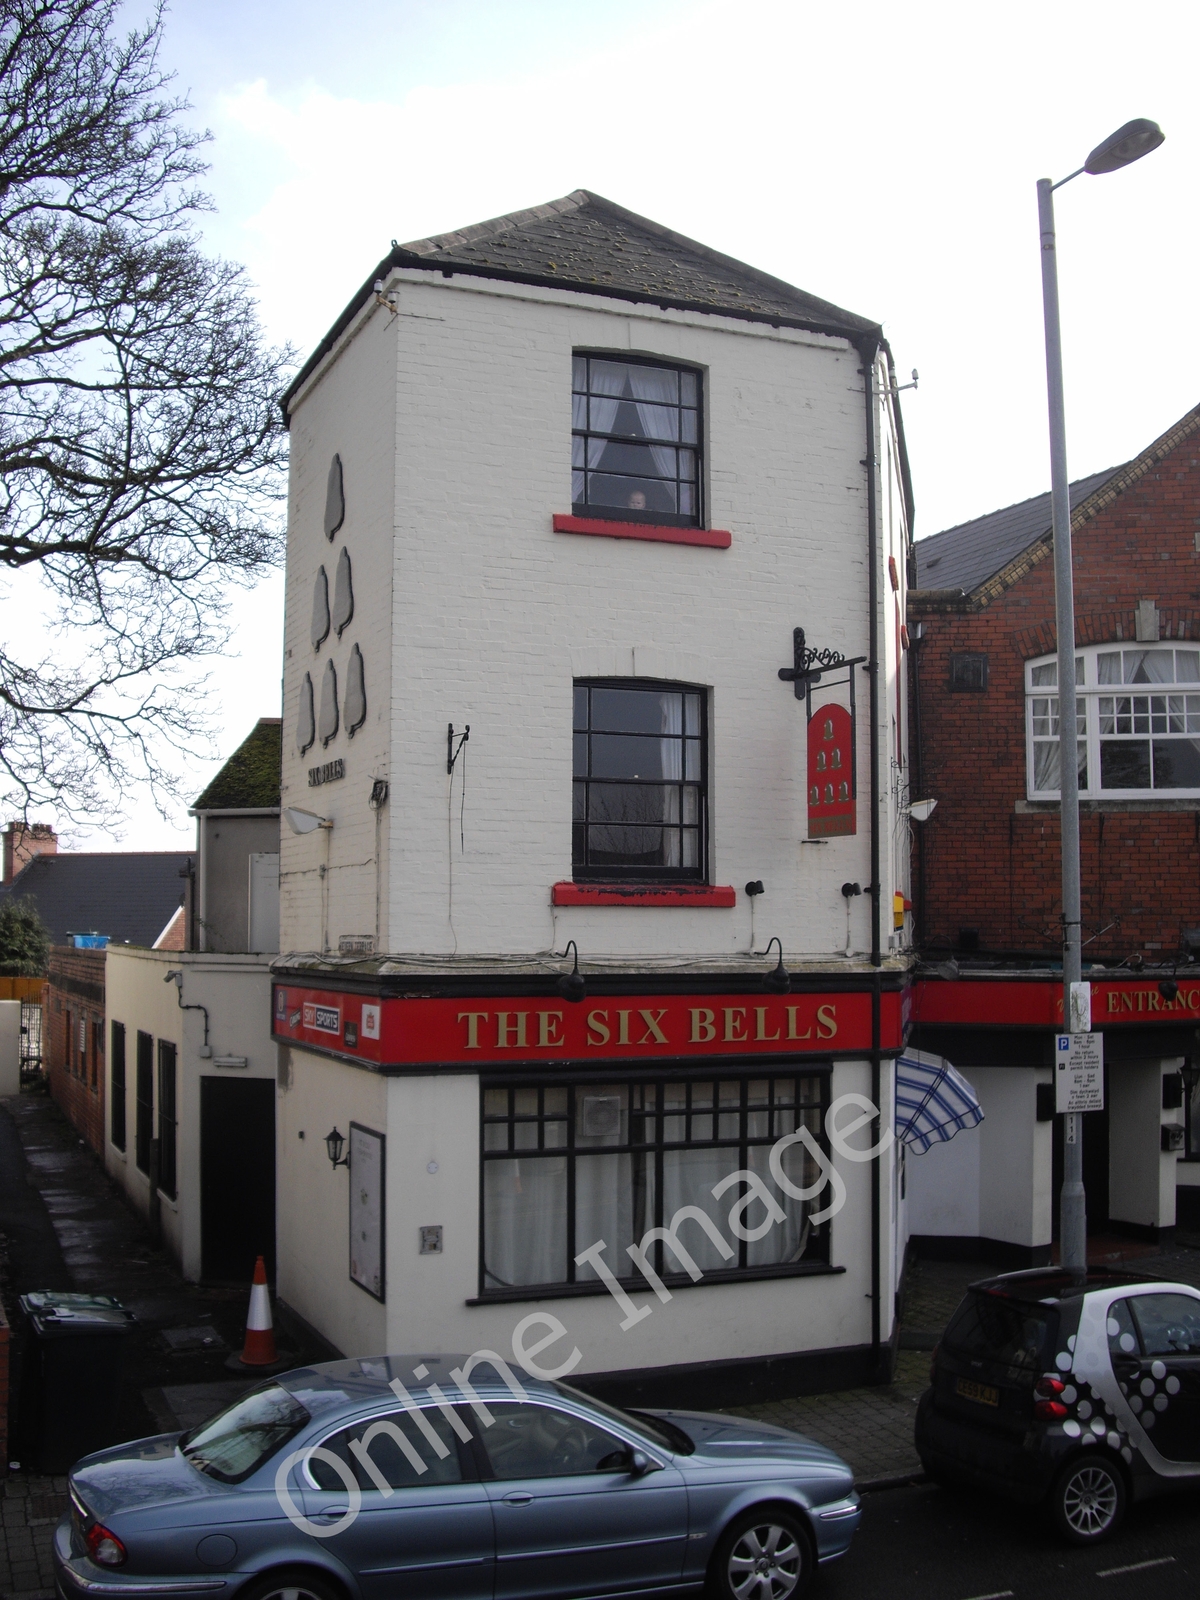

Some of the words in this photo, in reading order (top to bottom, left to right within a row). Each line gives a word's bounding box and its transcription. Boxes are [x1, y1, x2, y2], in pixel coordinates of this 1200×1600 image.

[317, 1011, 338, 1028] SPORTS
[457, 1011, 565, 1049] THE
[587, 1009, 669, 1046] SIX
[688, 1004, 838, 1043] BELLS
[1061, 1039, 1067, 1050] P
